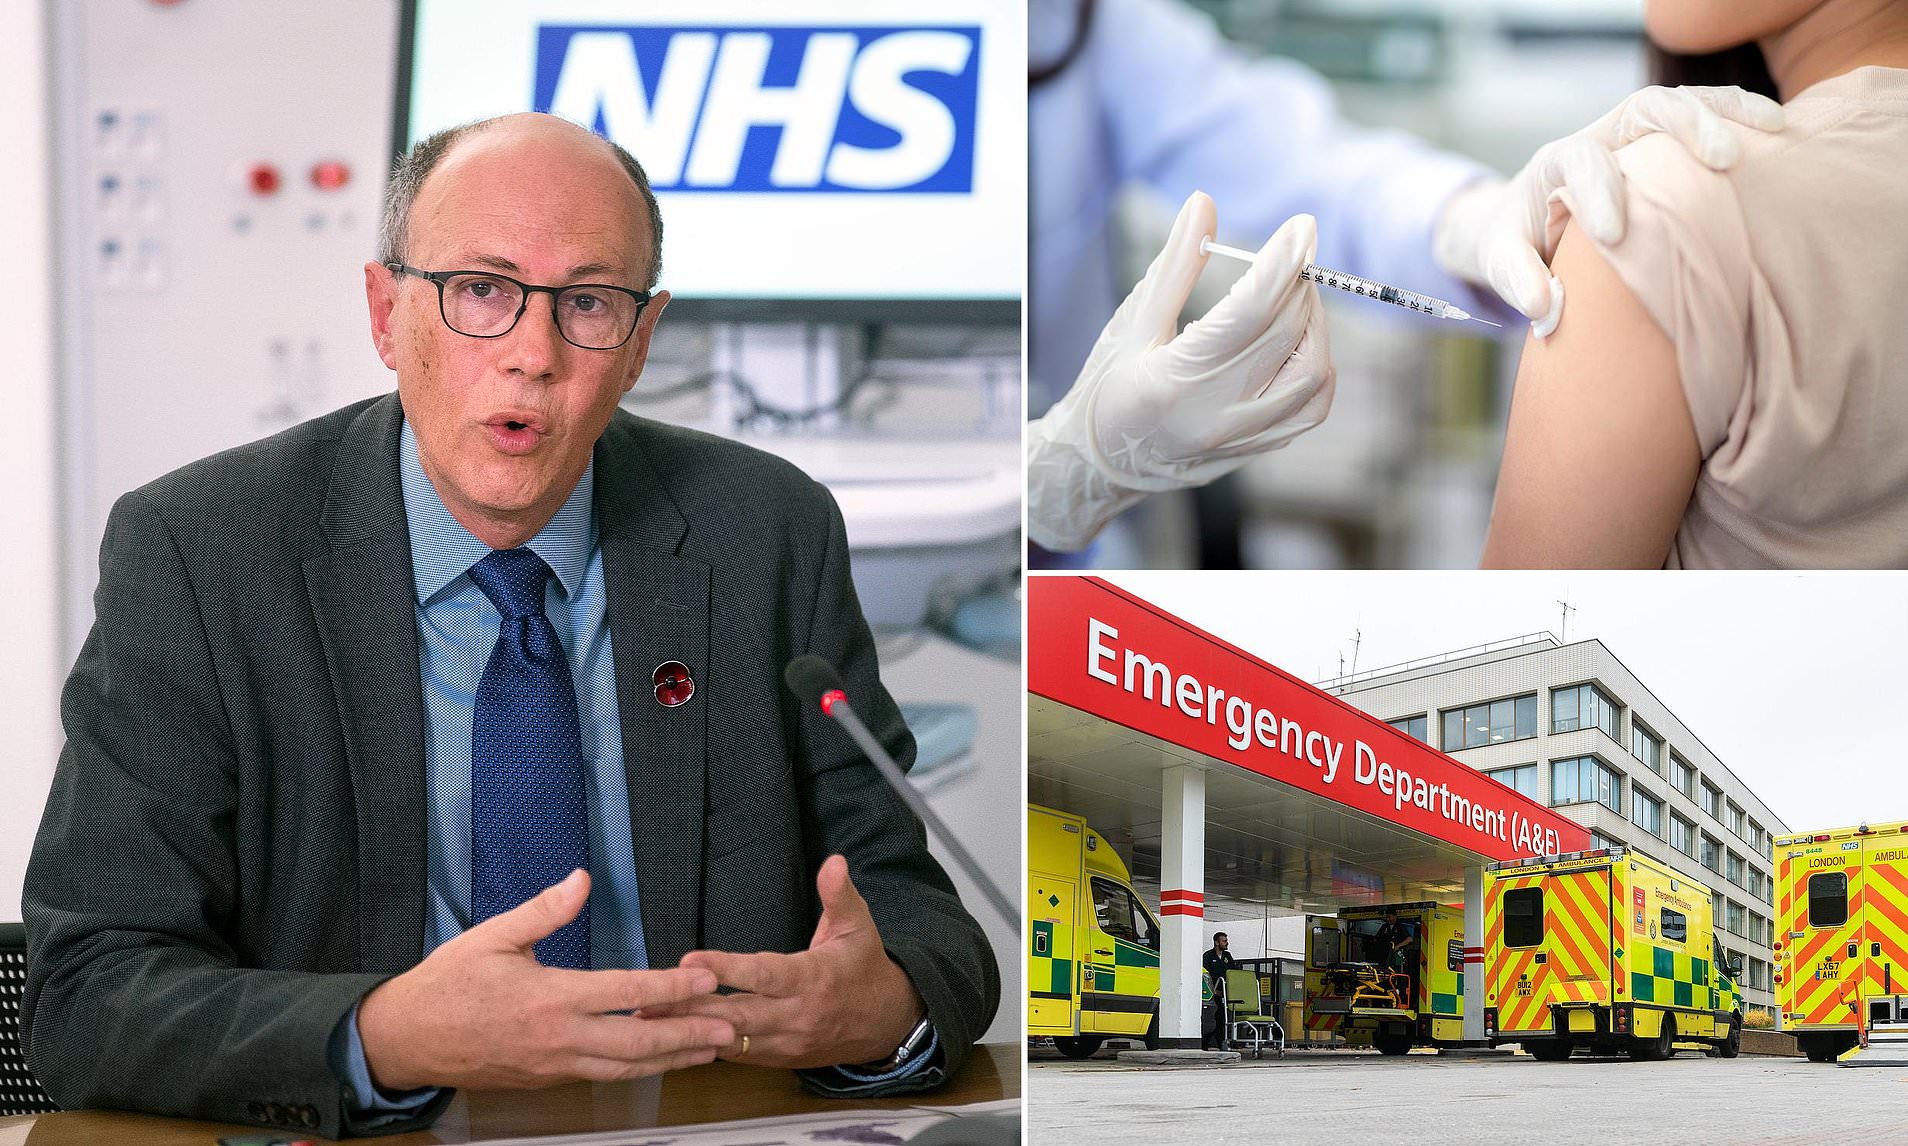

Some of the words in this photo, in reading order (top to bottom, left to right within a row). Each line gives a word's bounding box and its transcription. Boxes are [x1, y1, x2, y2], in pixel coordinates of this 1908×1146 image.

[548, 30, 974, 190] NHS
[1088, 617, 1344, 784] Emergency
[1354, 739, 1506, 841] Department
[1510, 811, 1560, 856] (A&E)
[1841, 842, 1858, 850] NHS
[1510, 866, 1540, 874] LONDON
[1558, 857, 1604, 868] AMBULANCE
[1809, 856, 1846, 868] LONDON
[1874, 850, 1908, 862] AMBUL
[1655, 887, 1674, 905] Emergency
[1674, 895, 1692, 911] Ambulance
[1817, 962, 1840, 971] LX67
[1822, 971, 1839, 979] AHY
[1517, 981, 1532, 989] BU12
